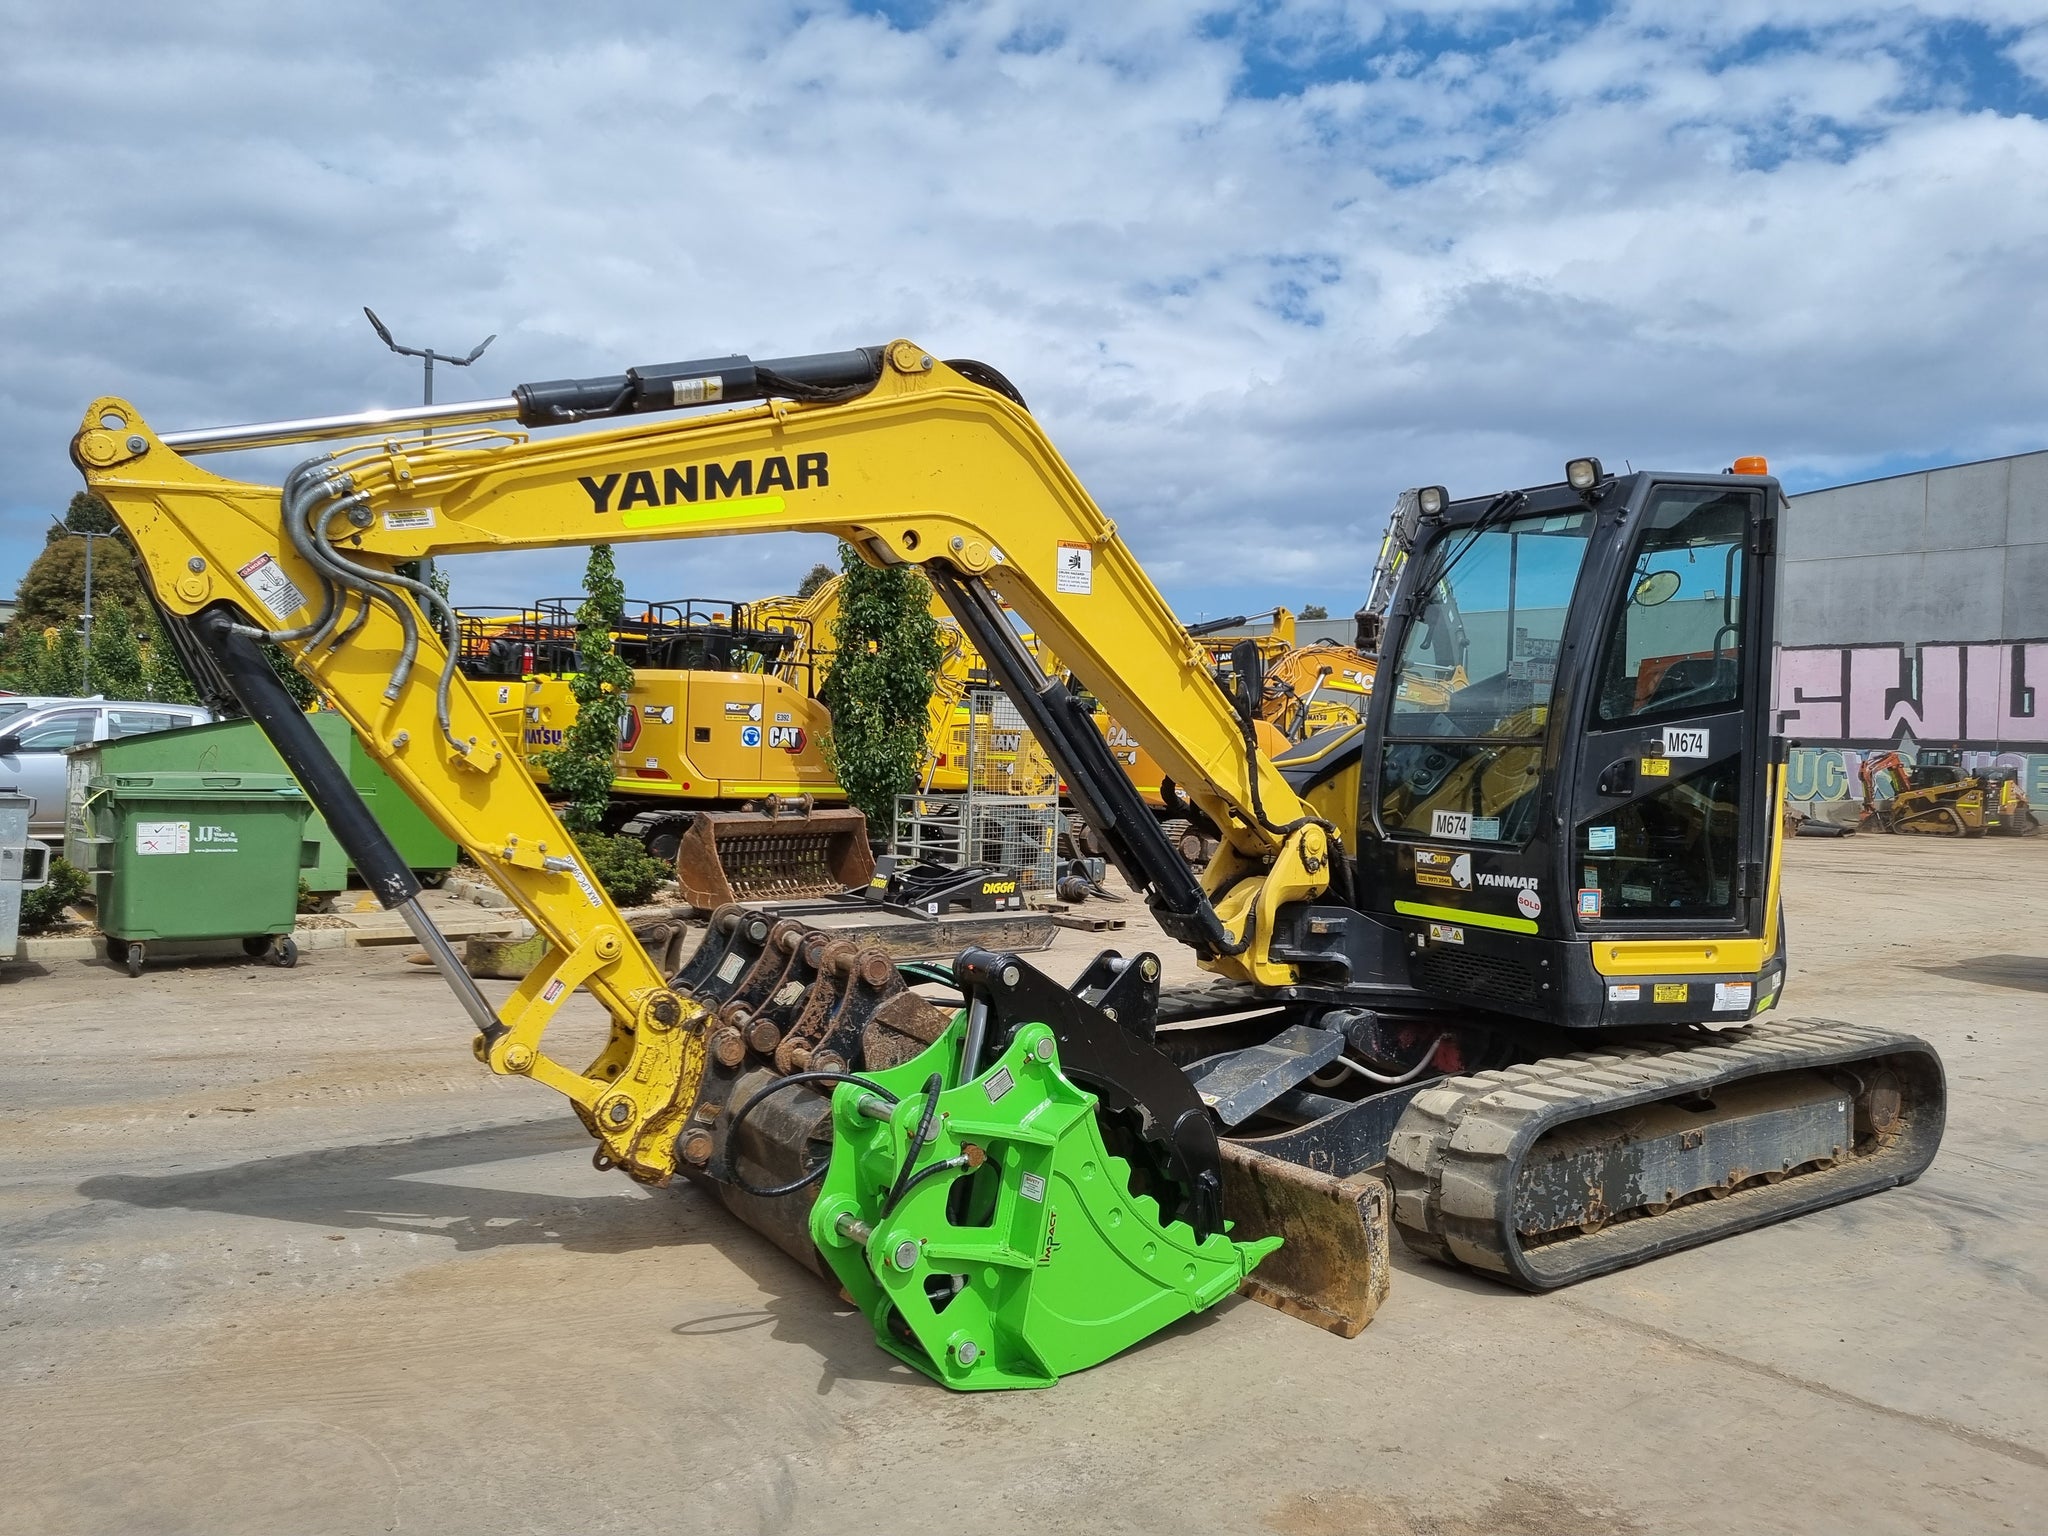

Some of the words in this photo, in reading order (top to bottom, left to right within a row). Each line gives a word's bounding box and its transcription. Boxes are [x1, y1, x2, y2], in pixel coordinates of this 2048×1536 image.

[577, 451, 829, 514] YANMAR
[243, 557, 267, 575] DANGER
[769, 727, 799, 748] CAT
[1668, 732, 1704, 753] M674
[1436, 814, 1467, 835] M674
[1416, 851, 1451, 864] PROQUIP
[870, 877, 888, 889] DIGGA
[982, 881, 1016, 895] DIGGA
[1476, 873, 1539, 891] YANMAR
[1518, 896, 1540, 911] SOLD
[1037, 1208, 1060, 1265] IMPACT
